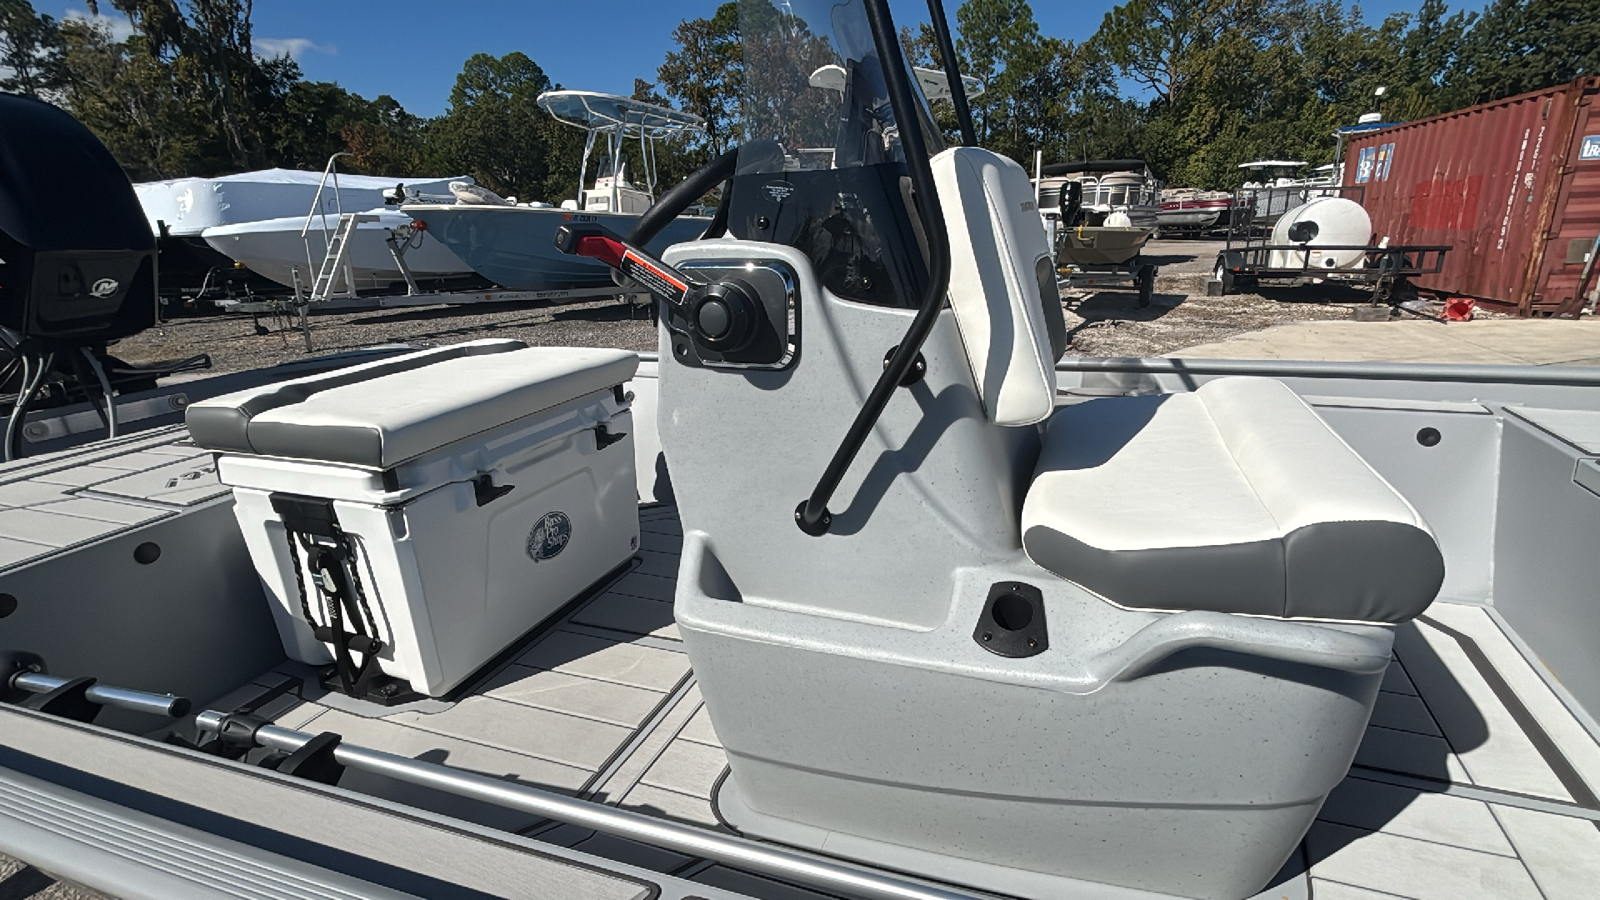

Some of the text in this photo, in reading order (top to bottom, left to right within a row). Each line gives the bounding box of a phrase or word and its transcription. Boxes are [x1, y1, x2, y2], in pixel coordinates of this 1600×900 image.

[544, 516, 561, 529] Bass
[546, 526, 559, 539] Pro
[547, 533, 568, 549] Shops
